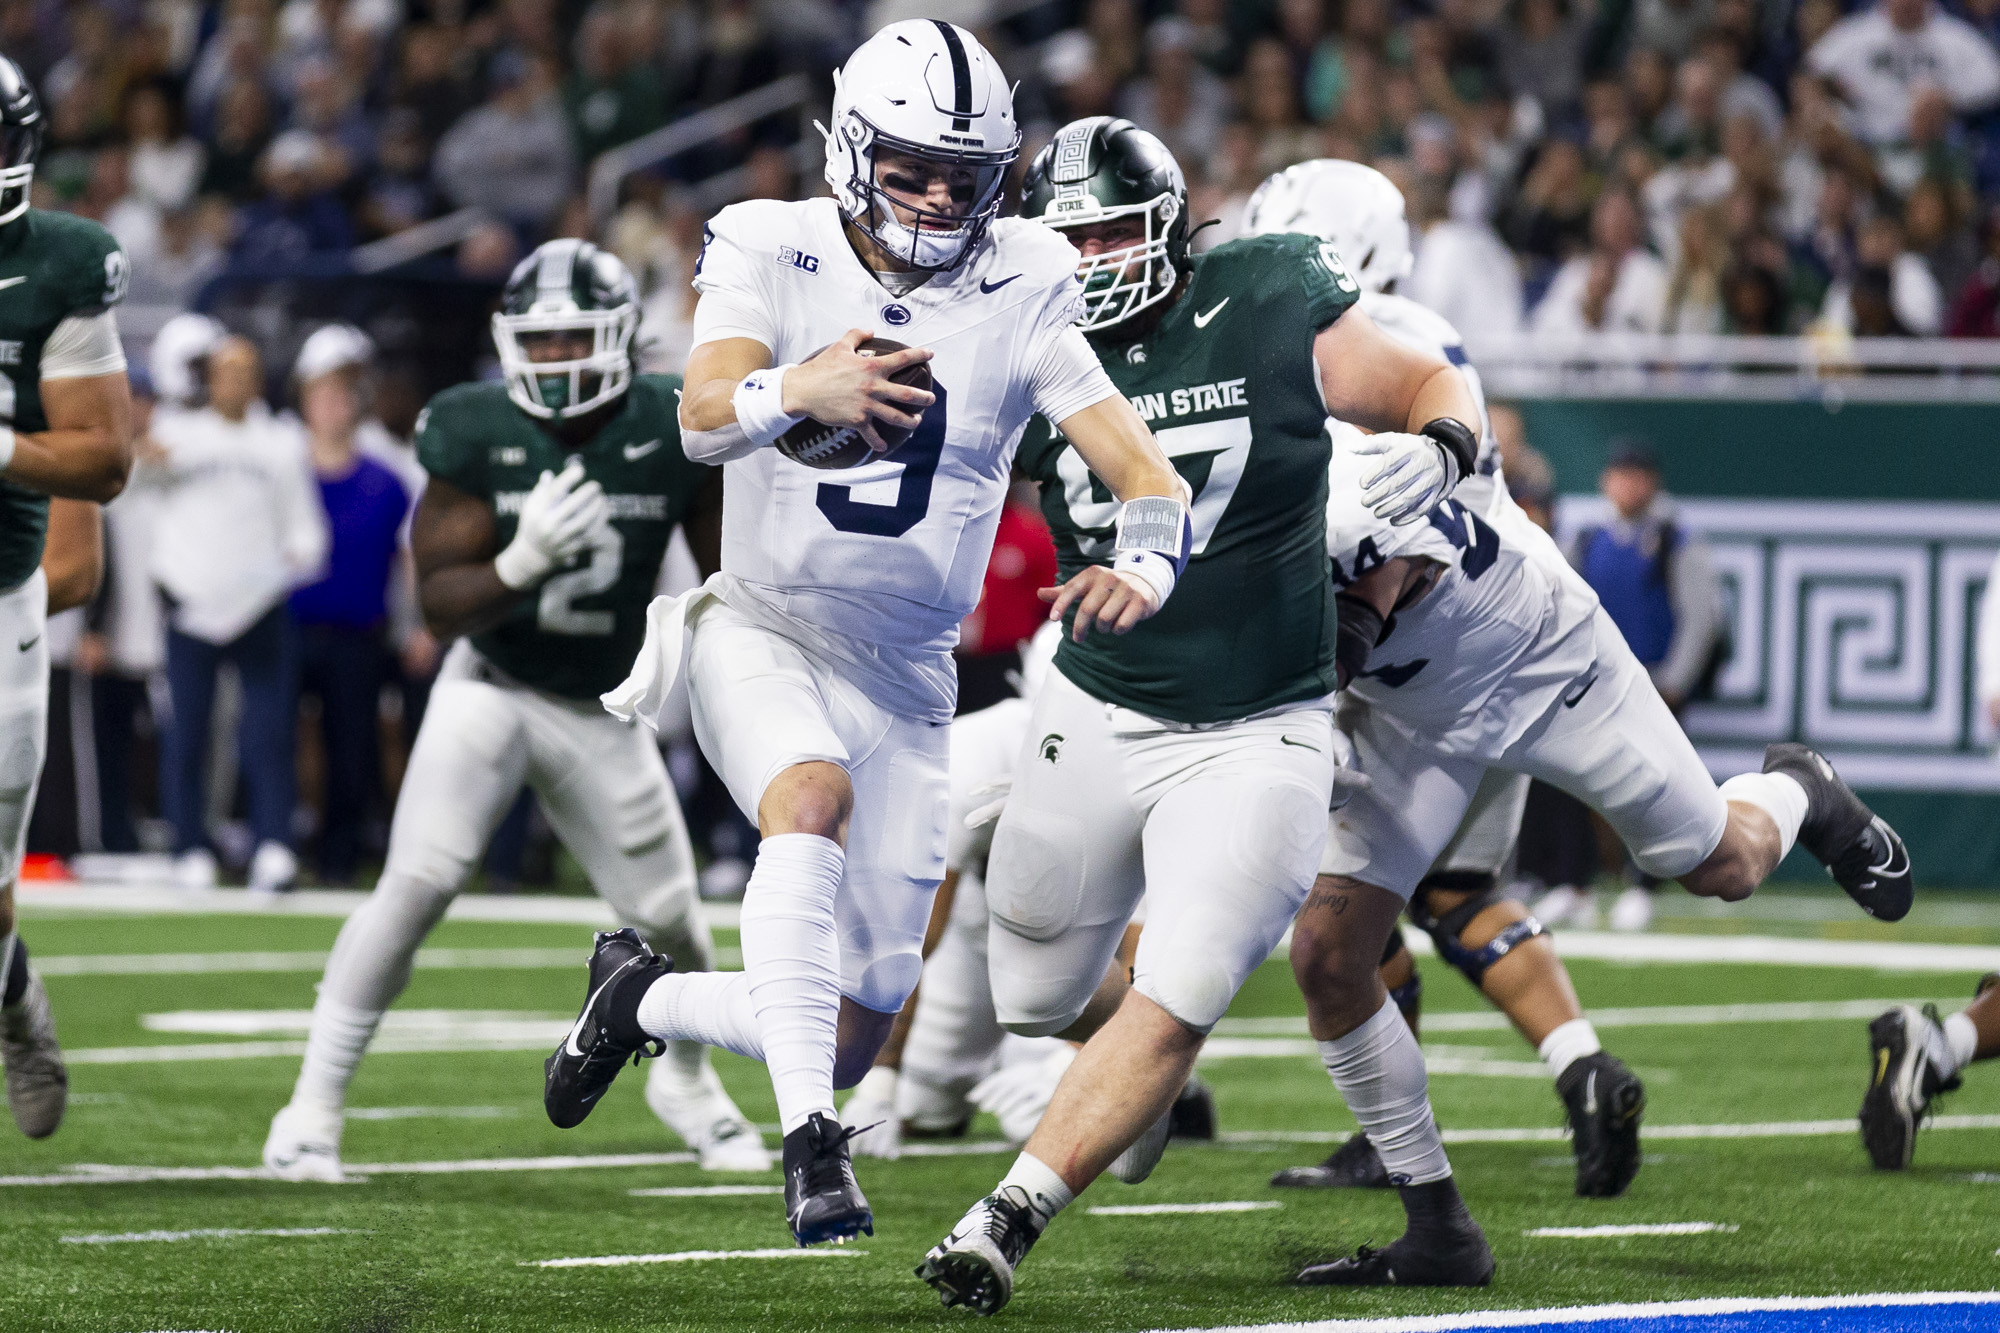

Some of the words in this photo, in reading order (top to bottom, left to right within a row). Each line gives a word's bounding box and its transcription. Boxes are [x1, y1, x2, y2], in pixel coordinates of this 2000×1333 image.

[939, 134, 961, 145] PENN
[962, 137, 985, 149] STATE
[1057, 199, 1086, 212] STATE
[1170, 377, 1249, 416] STATE
[538, 520, 625, 635] 2
